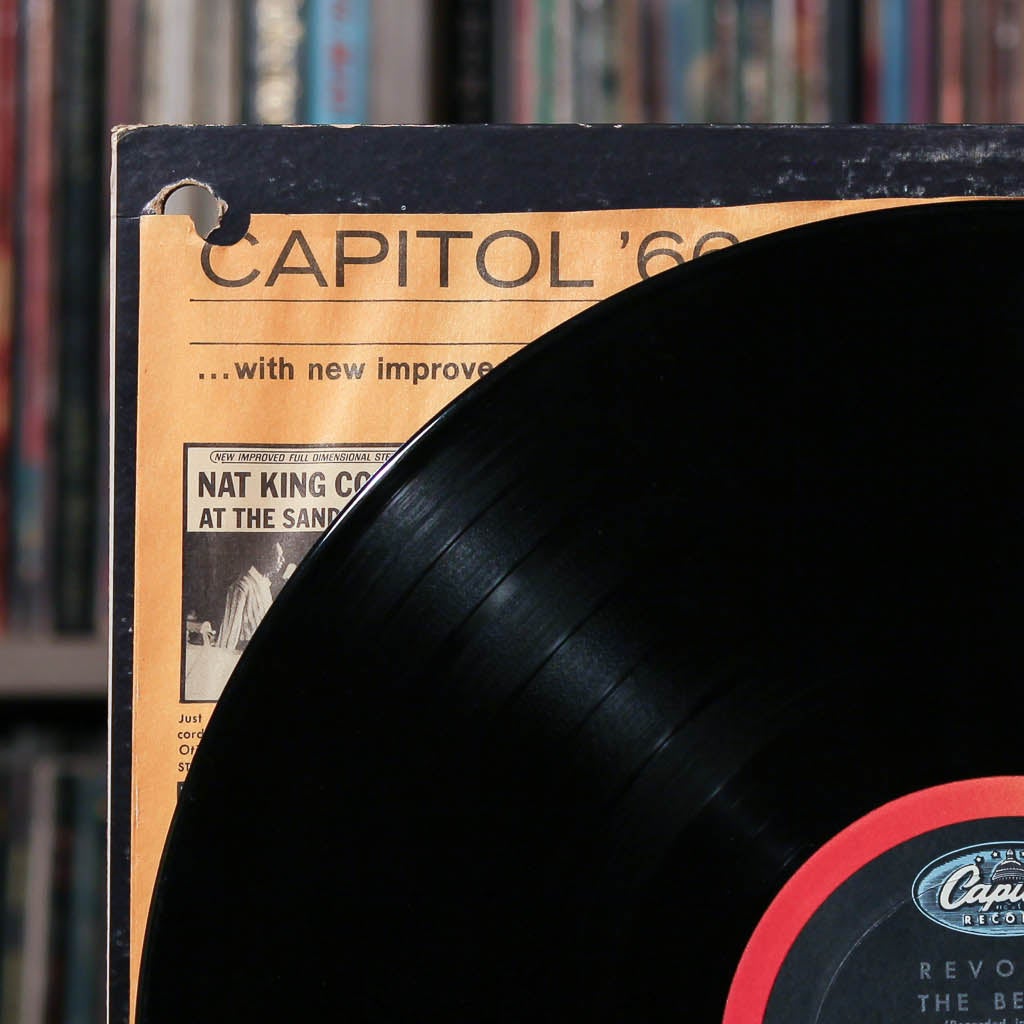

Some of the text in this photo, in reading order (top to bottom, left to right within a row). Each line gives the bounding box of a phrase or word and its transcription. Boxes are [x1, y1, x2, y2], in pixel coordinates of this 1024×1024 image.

[200, 230, 595, 288] CAPITOL
[308, 361, 365, 380] new
[215, 453, 234, 461] NEW
[238, 453, 285, 462] IMPROVED
[289, 453, 309, 461] FULL
[313, 453, 371, 461] DIMENSIONAL
[199, 472, 251, 498] NAT
[261, 472, 326, 497] KING
[200, 509, 226, 528] AT
[233, 509, 275, 528] THE
[179, 714, 202, 724] Just
[918, 993, 969, 1013] THE
